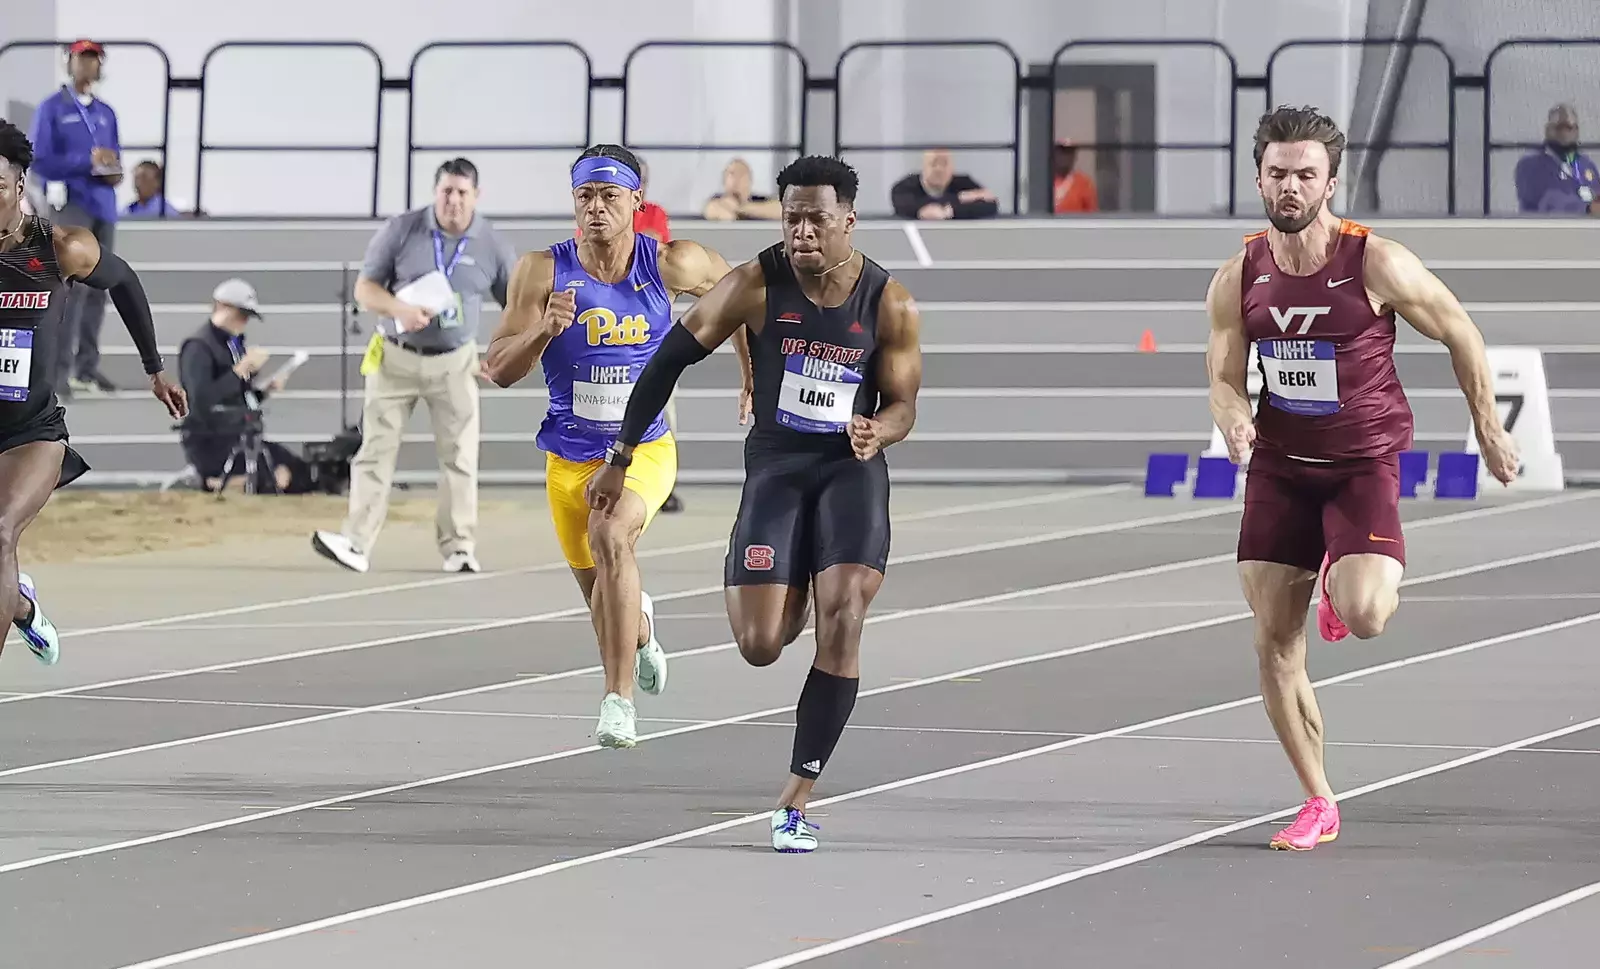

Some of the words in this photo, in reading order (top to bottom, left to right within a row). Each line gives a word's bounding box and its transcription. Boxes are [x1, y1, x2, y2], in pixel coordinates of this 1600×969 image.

[577, 308, 650, 346] Pitt
[1269, 306, 1331, 335] VT
[780, 338, 806, 355] NC
[808, 341, 864, 364] STATE
[1272, 340, 1316, 359] UNITE
[590, 365, 631, 383] UNITE
[801, 356, 845, 382] UNITE
[1278, 370, 1317, 387] BECK
[799, 388, 835, 407] LANG
